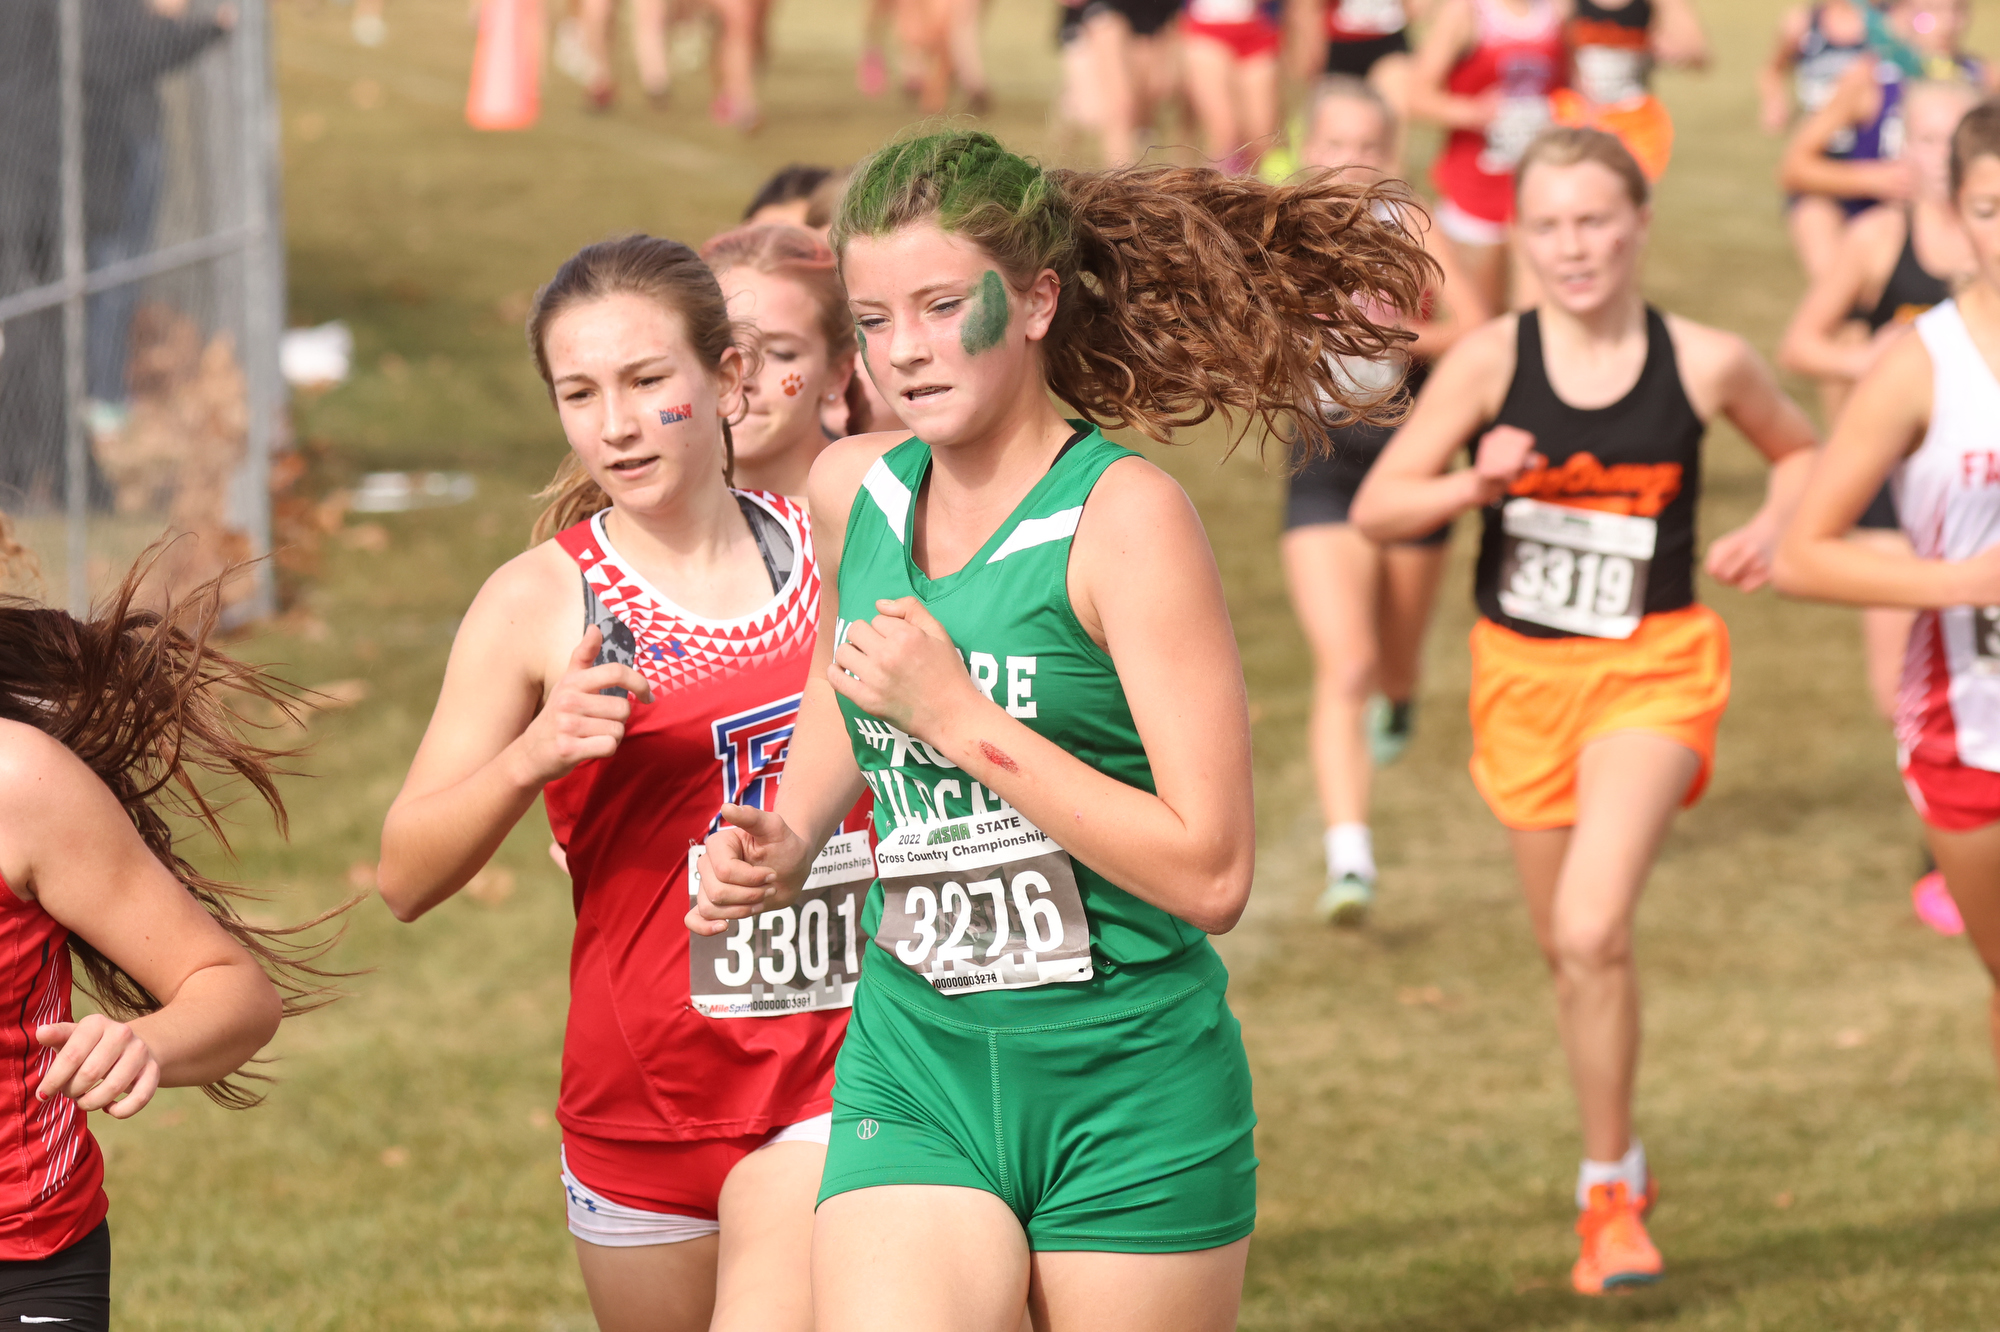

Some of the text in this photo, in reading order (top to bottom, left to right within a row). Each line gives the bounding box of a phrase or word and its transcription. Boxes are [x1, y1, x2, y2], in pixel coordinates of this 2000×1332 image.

[1510, 541, 1635, 616] 3319
[878, 829, 1050, 864] Cross Country Championship
[898, 833, 921, 846] 2022
[976, 816, 1021, 835] STATE
[812, 856, 872, 876] ampionships
[821, 842, 852, 857] STATE
[895, 869, 1065, 966] 3276
[713, 892, 859, 987] 3301
